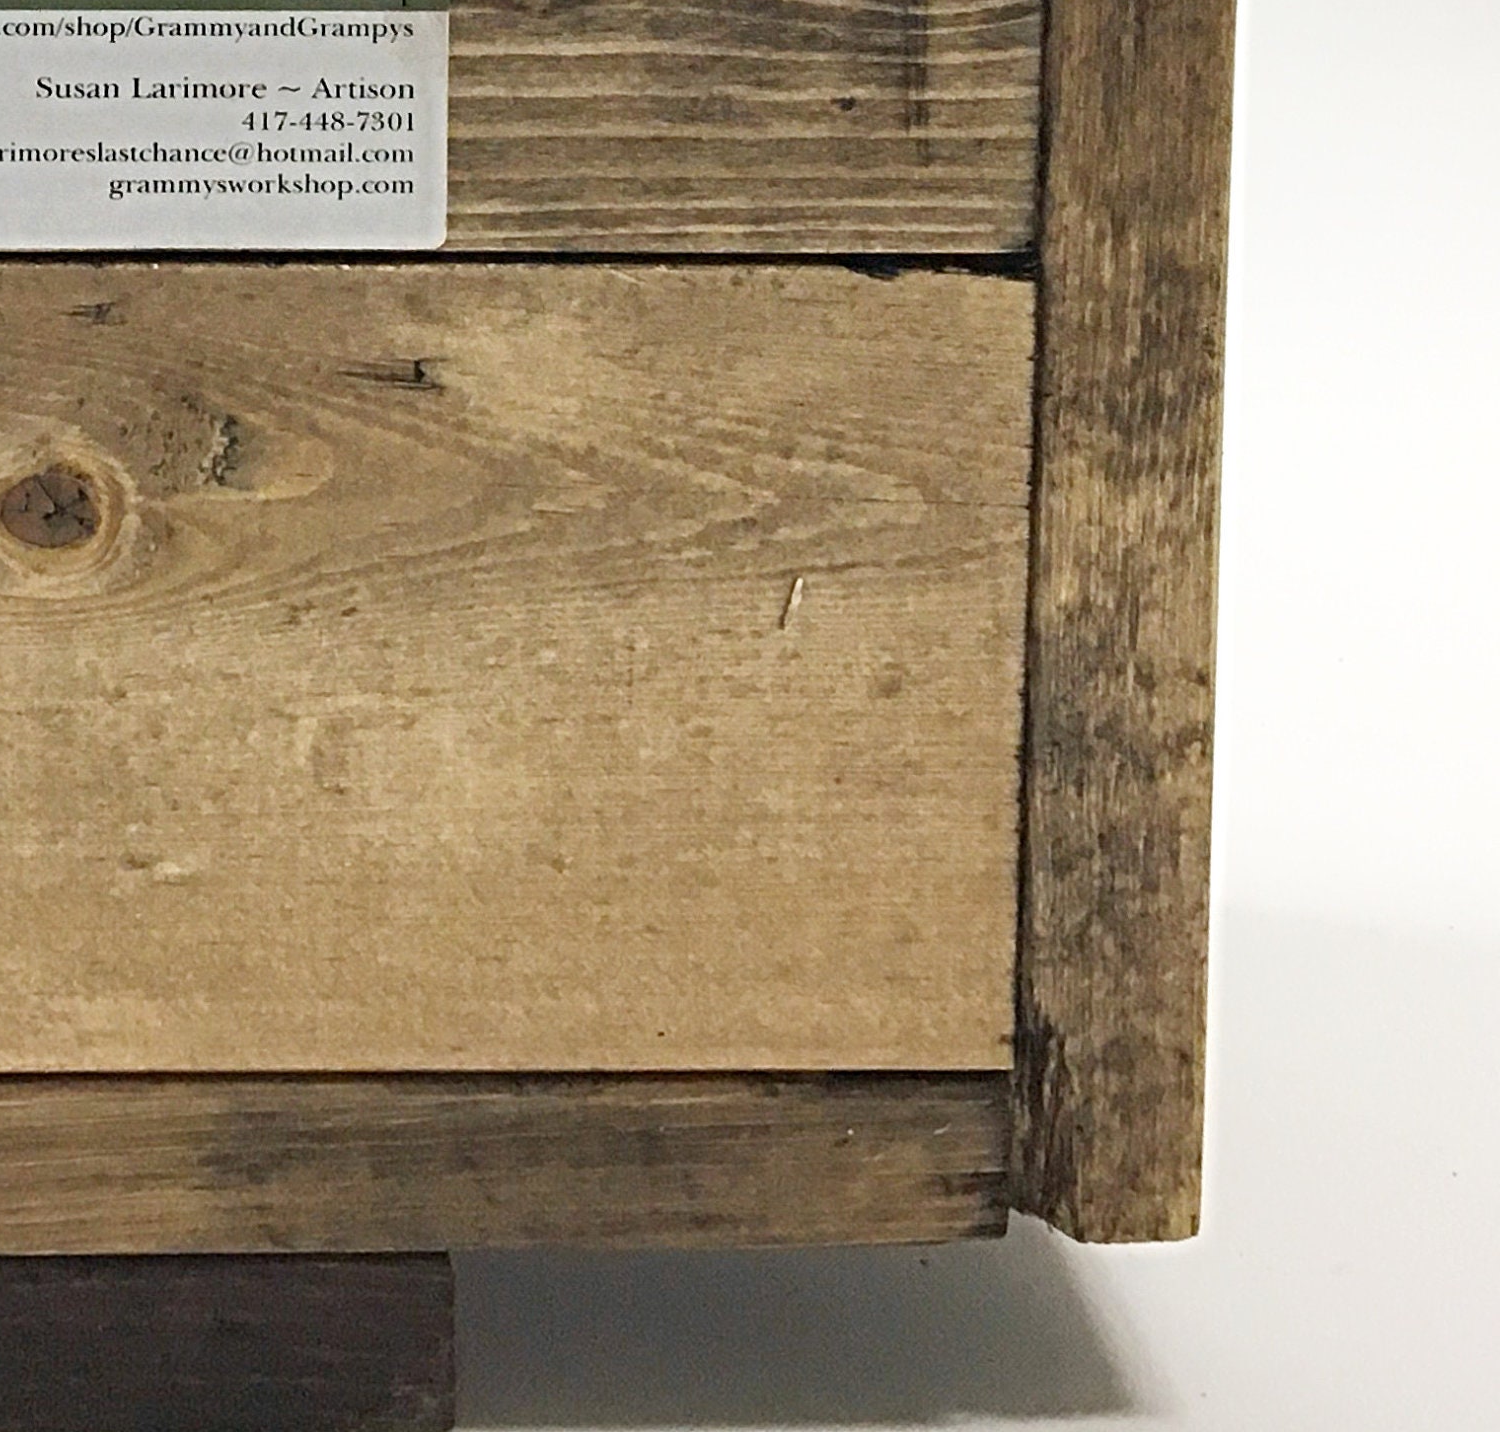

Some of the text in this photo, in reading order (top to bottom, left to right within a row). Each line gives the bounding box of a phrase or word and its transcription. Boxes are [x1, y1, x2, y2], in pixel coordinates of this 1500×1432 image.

[36, 77, 119, 99] Susan
[132, 76, 267, 99] Larimore
[311, 77, 414, 100] Artison
[241, 111, 414, 132] 417-448-7301
[108, 173, 414, 200] grammysworkshop.com
